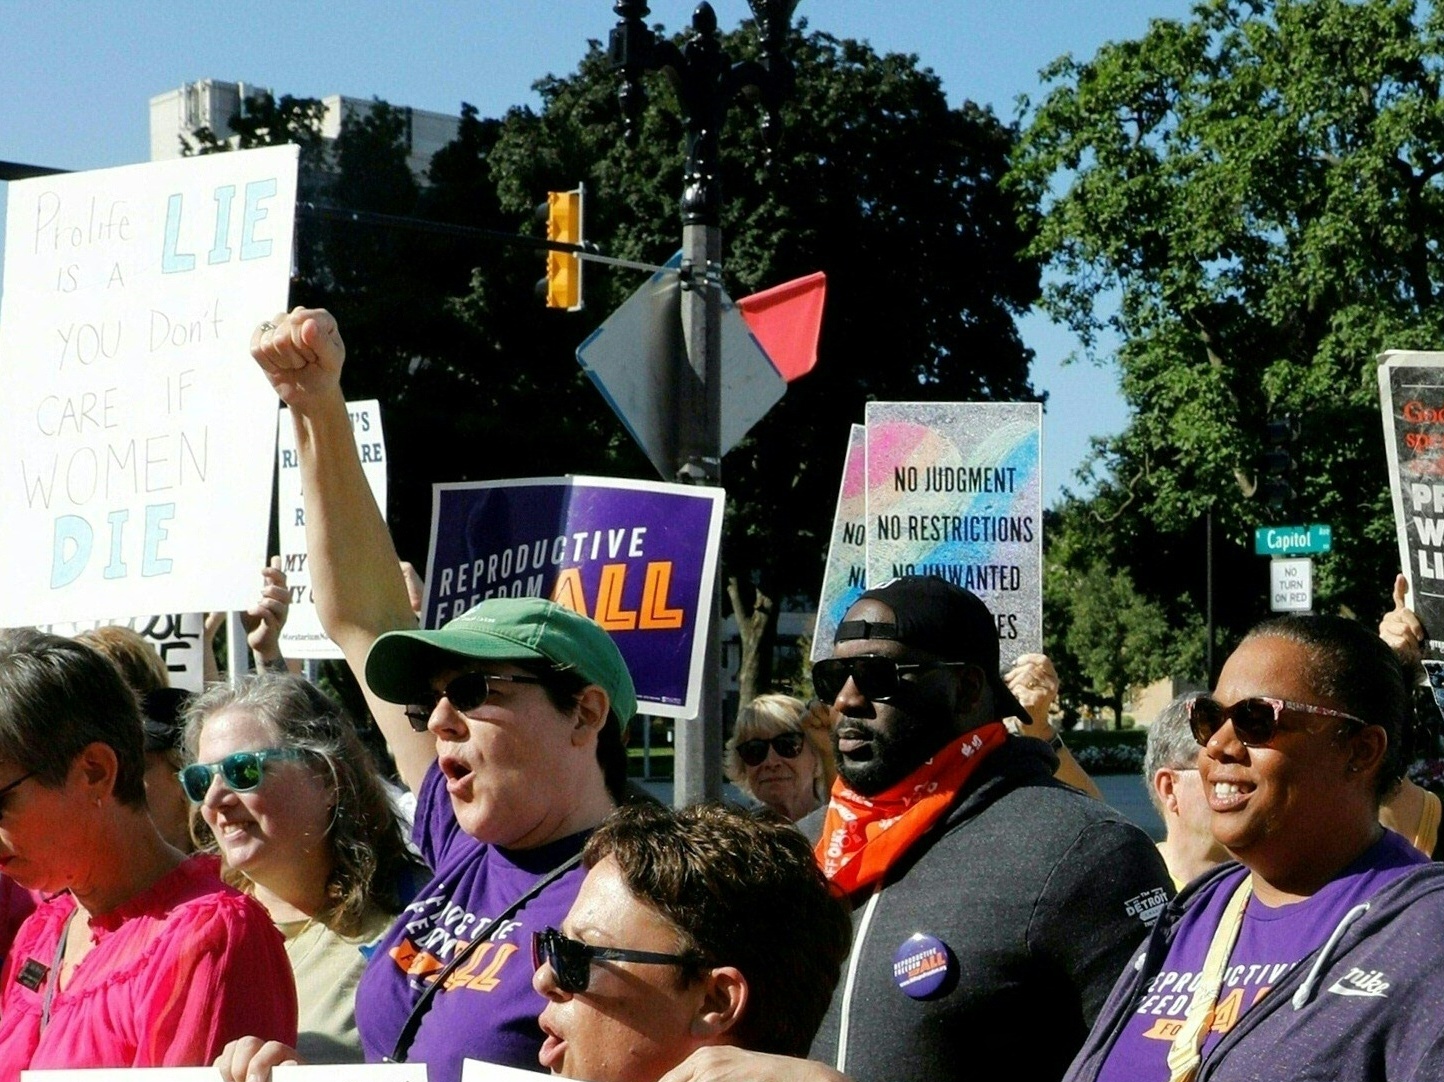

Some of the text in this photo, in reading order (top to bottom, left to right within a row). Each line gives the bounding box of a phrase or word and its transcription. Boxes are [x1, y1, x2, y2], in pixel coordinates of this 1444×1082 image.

[34, 177, 278, 275] Prolife LIE
[57, 261, 125, 293] IS A
[57, 297, 225, 371] YOU Don't
[36, 368, 196, 437] CARE IF
[20, 424, 209, 510] WOMEN
[894, 466, 1017, 494] NO JUDGMENT
[878, 515, 1034, 543] NO RESTRICTIONS
[1267, 529, 1312, 552] Capitol
[50, 502, 176, 590] DIE
[439, 527, 648, 598] REPRODUCTIVE
[1284, 567, 1298, 577] NO
[1275, 592, 1307, 603] ON RED
[1279, 580, 1303, 590] TURN
[1125, 892, 1169, 917] DETROIT
[1159, 1023, 1182, 1036] FO
